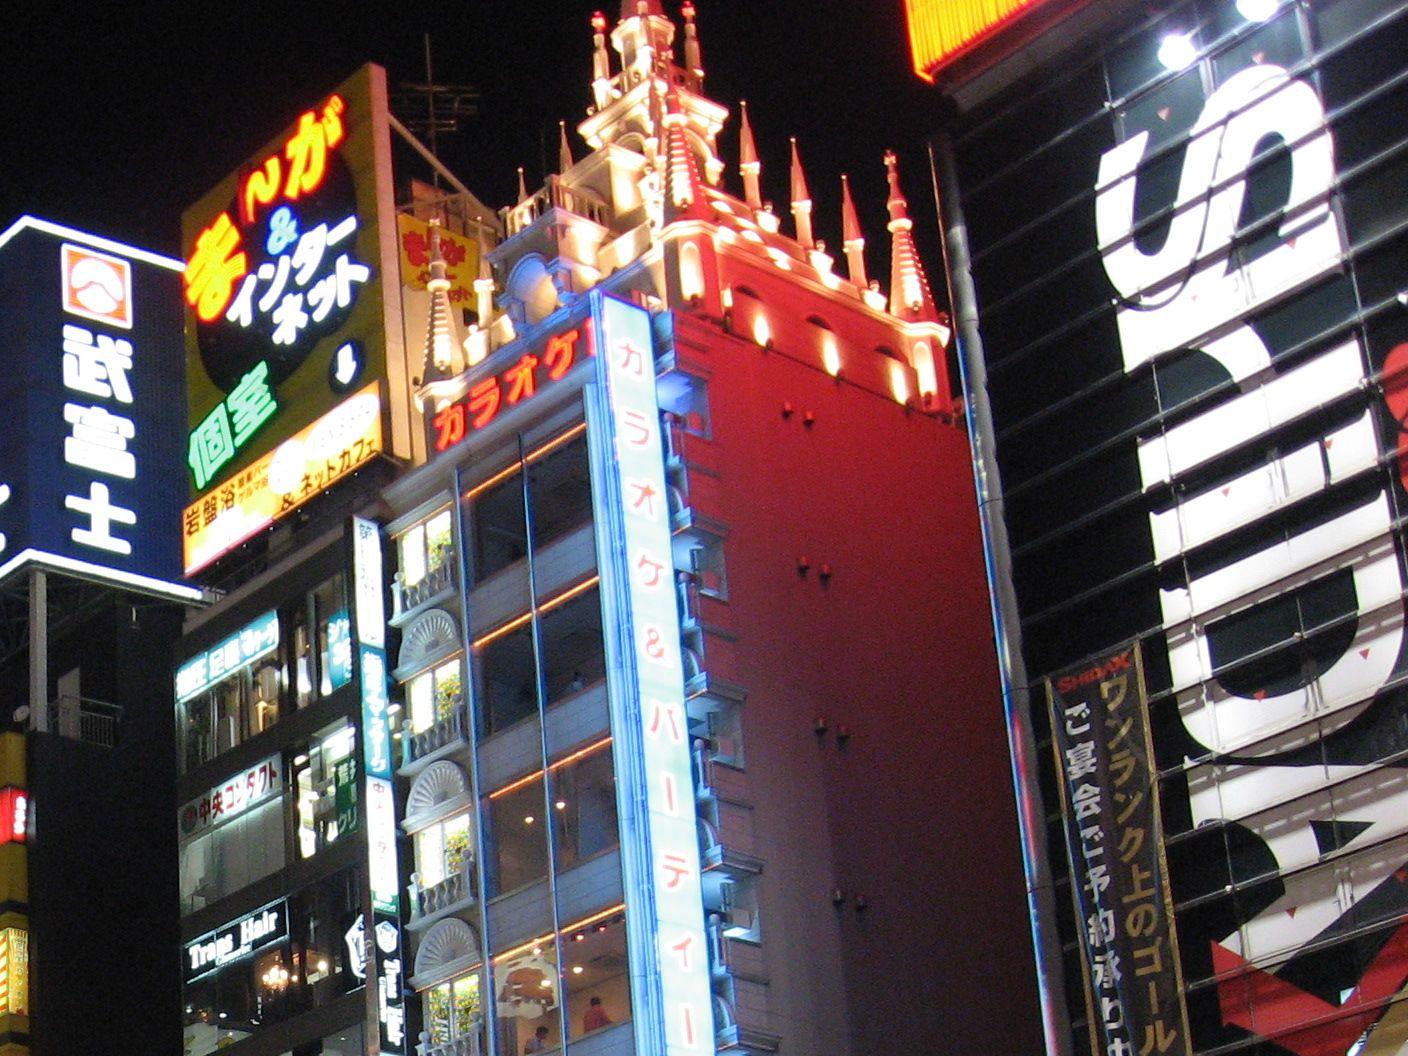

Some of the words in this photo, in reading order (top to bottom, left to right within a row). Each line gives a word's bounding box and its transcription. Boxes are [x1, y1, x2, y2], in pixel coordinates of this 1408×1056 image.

[184, 93, 345, 322] まんが
[266, 205, 297, 257] &
[226, 215, 358, 329] インター
[271, 263, 371, 346] ネット
[61, 324, 138, 556] 武富士
[188, 361, 280, 490] 個室
[434, 316, 595, 453] カラオケ
[300, 437, 379, 497] ネットカフェ
[1056, 652, 1131, 694] SHIDAX
